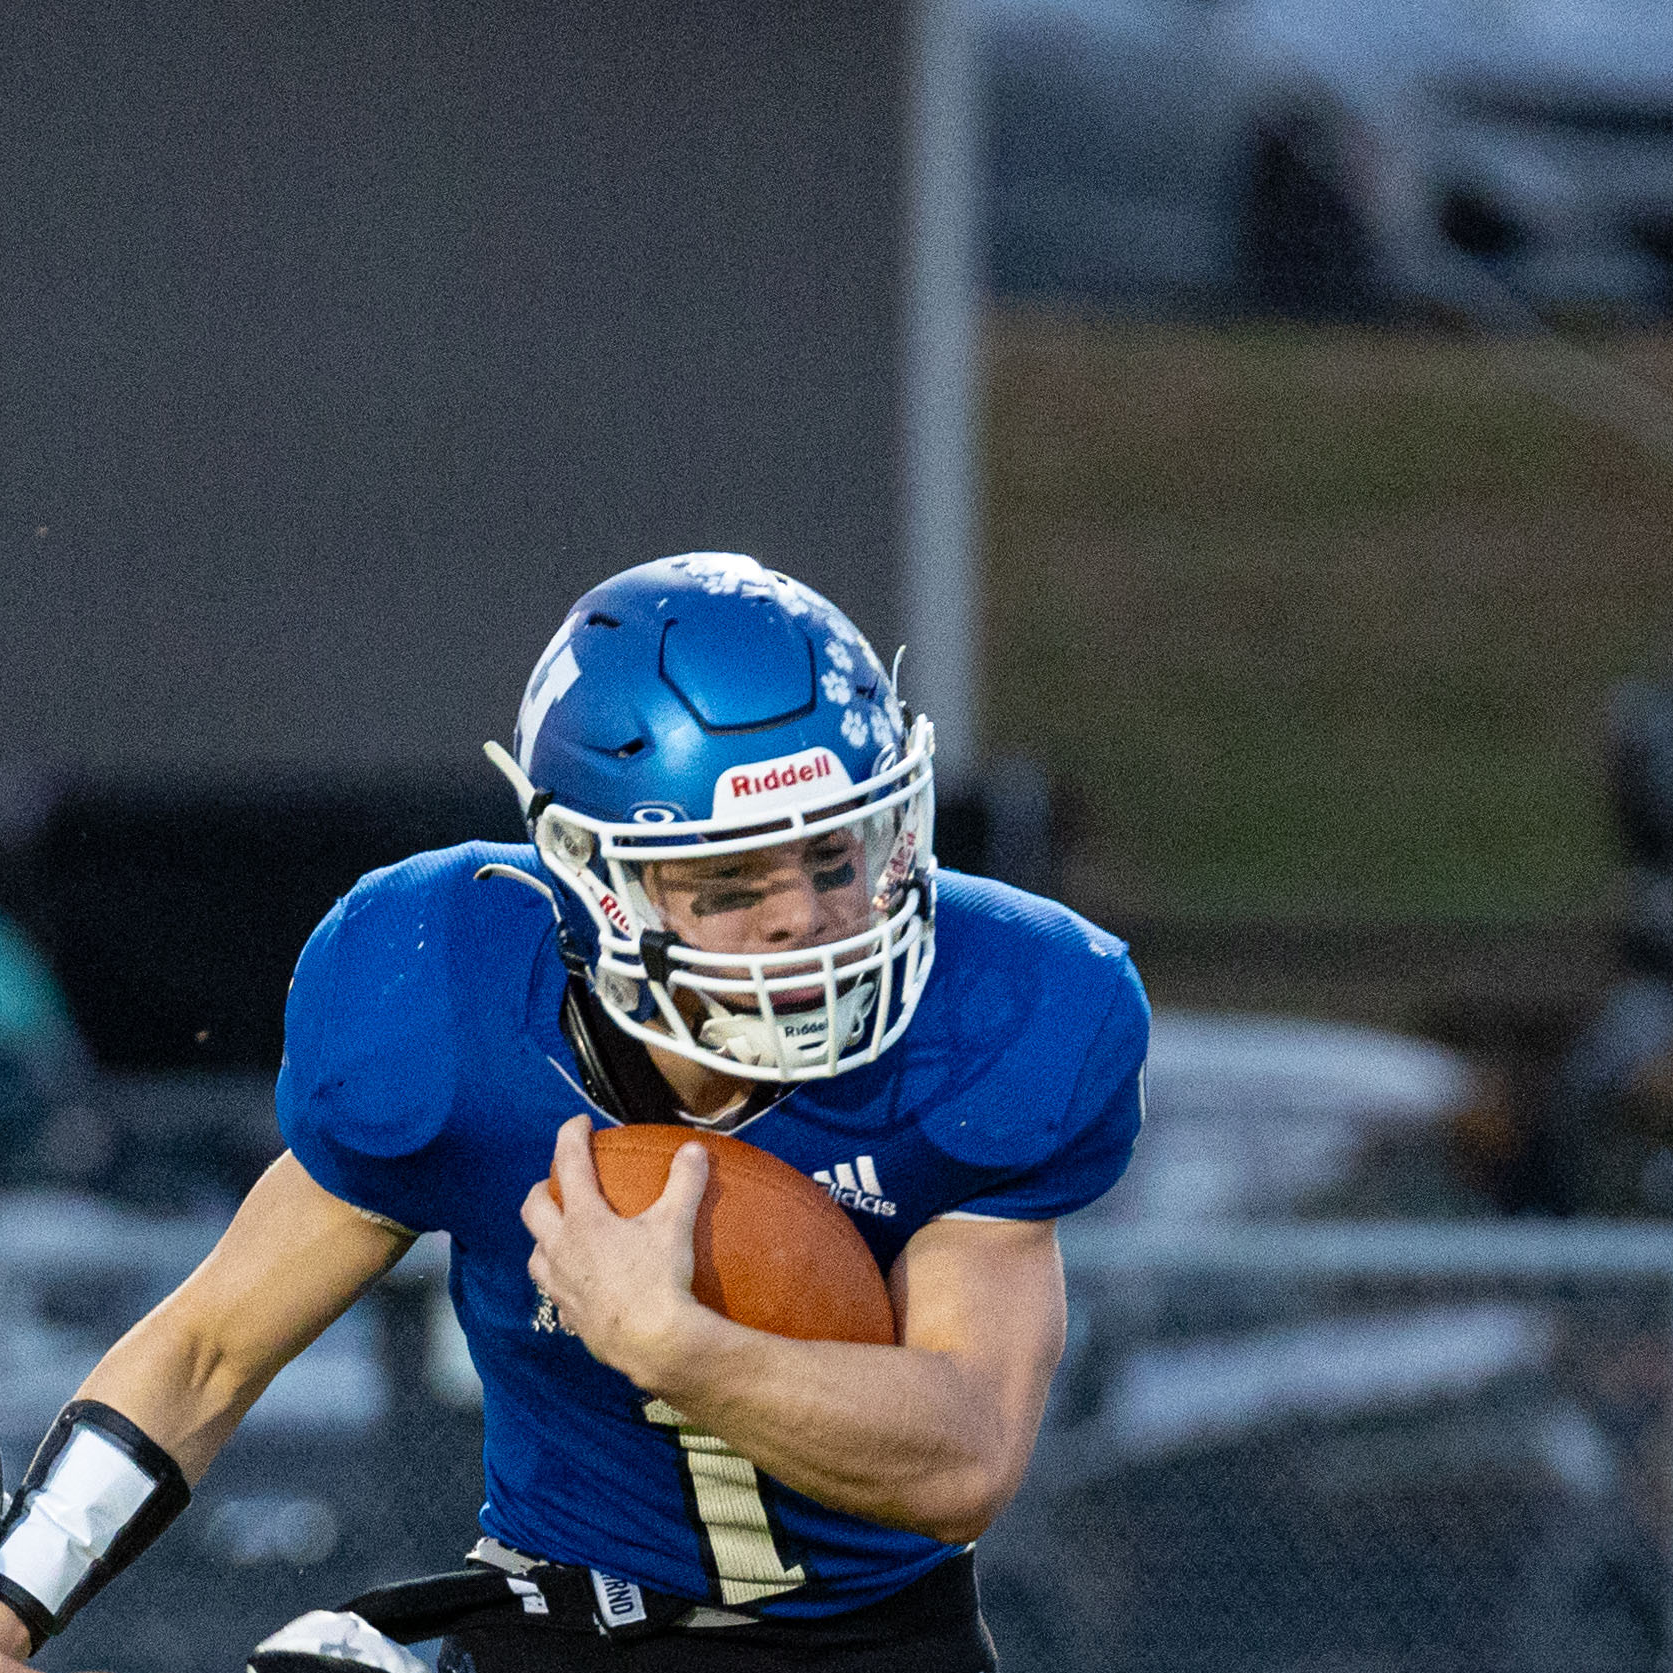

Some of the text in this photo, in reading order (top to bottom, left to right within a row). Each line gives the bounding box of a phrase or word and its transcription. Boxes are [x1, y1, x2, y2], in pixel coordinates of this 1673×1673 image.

[731, 754, 831, 798] Riddell
[784, 1018, 829, 1037] Riddel
[603, 1575, 634, 1616] RND
